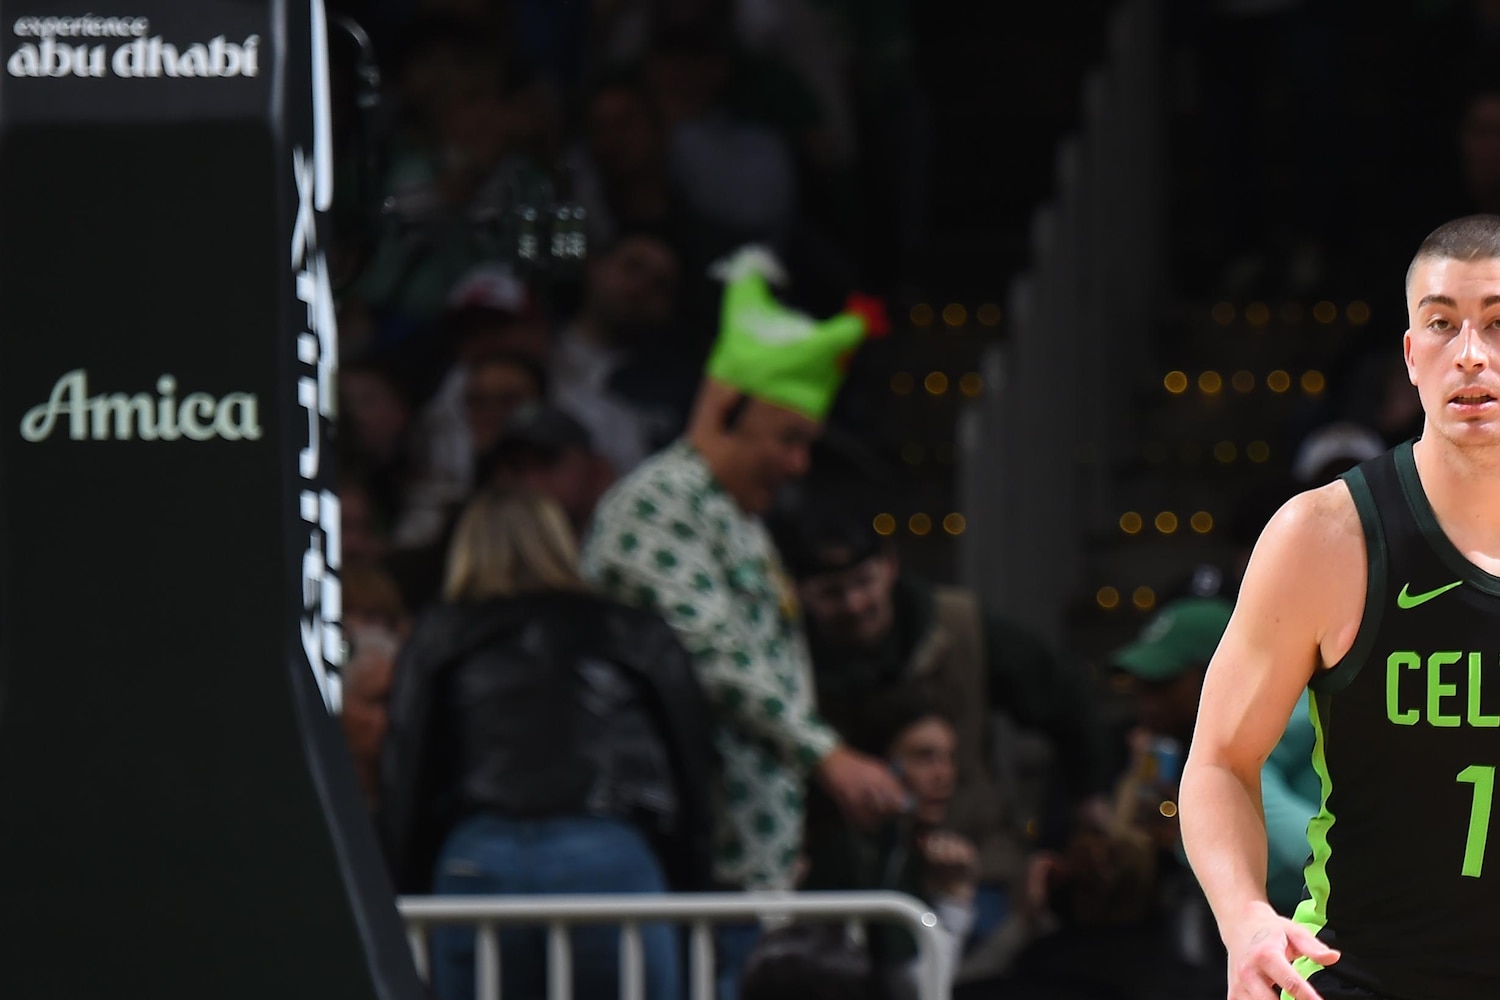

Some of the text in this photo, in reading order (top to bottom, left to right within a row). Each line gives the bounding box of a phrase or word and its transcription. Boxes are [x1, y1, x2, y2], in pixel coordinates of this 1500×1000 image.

[13, 13, 149, 40] experience
[7, 34, 261, 78] abu dhabi
[19, 367, 263, 443] Amica
